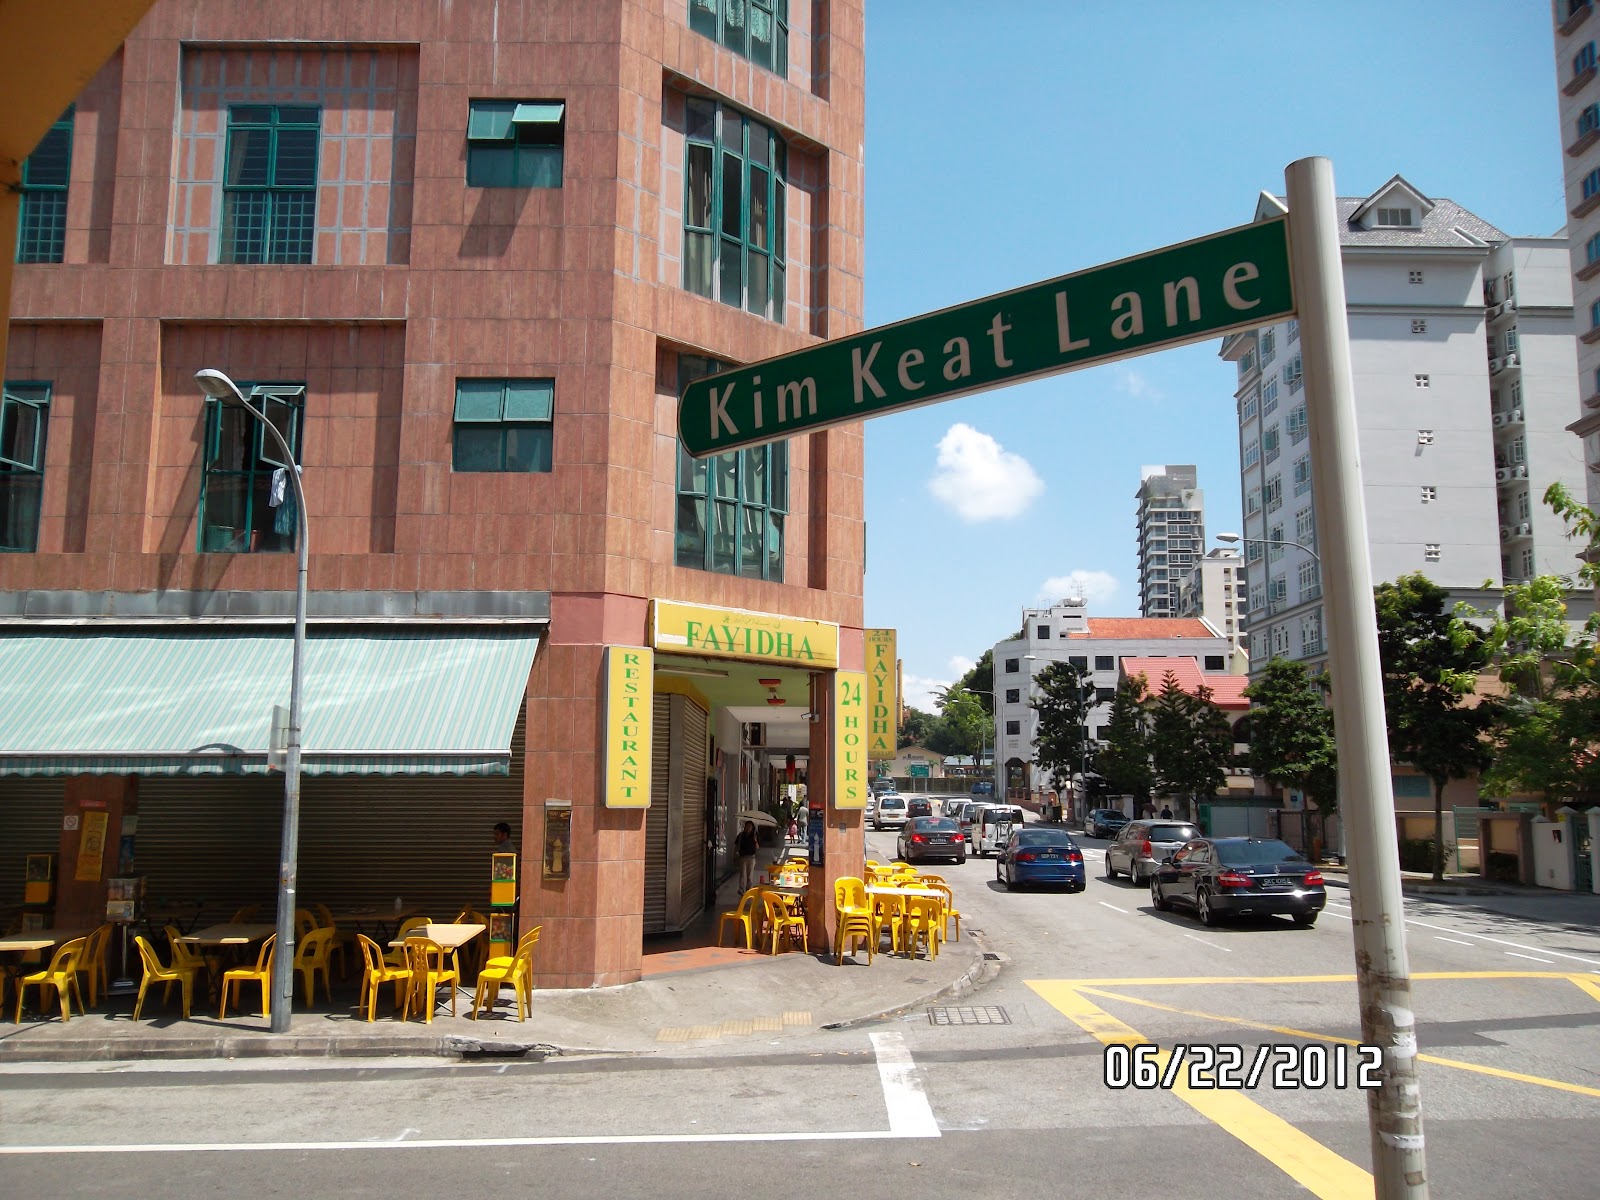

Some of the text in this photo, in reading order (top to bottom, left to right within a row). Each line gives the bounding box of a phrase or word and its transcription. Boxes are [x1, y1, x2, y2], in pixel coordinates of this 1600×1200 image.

[709, 261, 1262, 440] Kim Keat Lane
[687, 621, 814, 660] FAYIDHA
[873, 644, 888, 749] FAYIDHA
[620, 653, 640, 798] RESTAURANT
[841, 681, 862, 800] 24 HOURS
